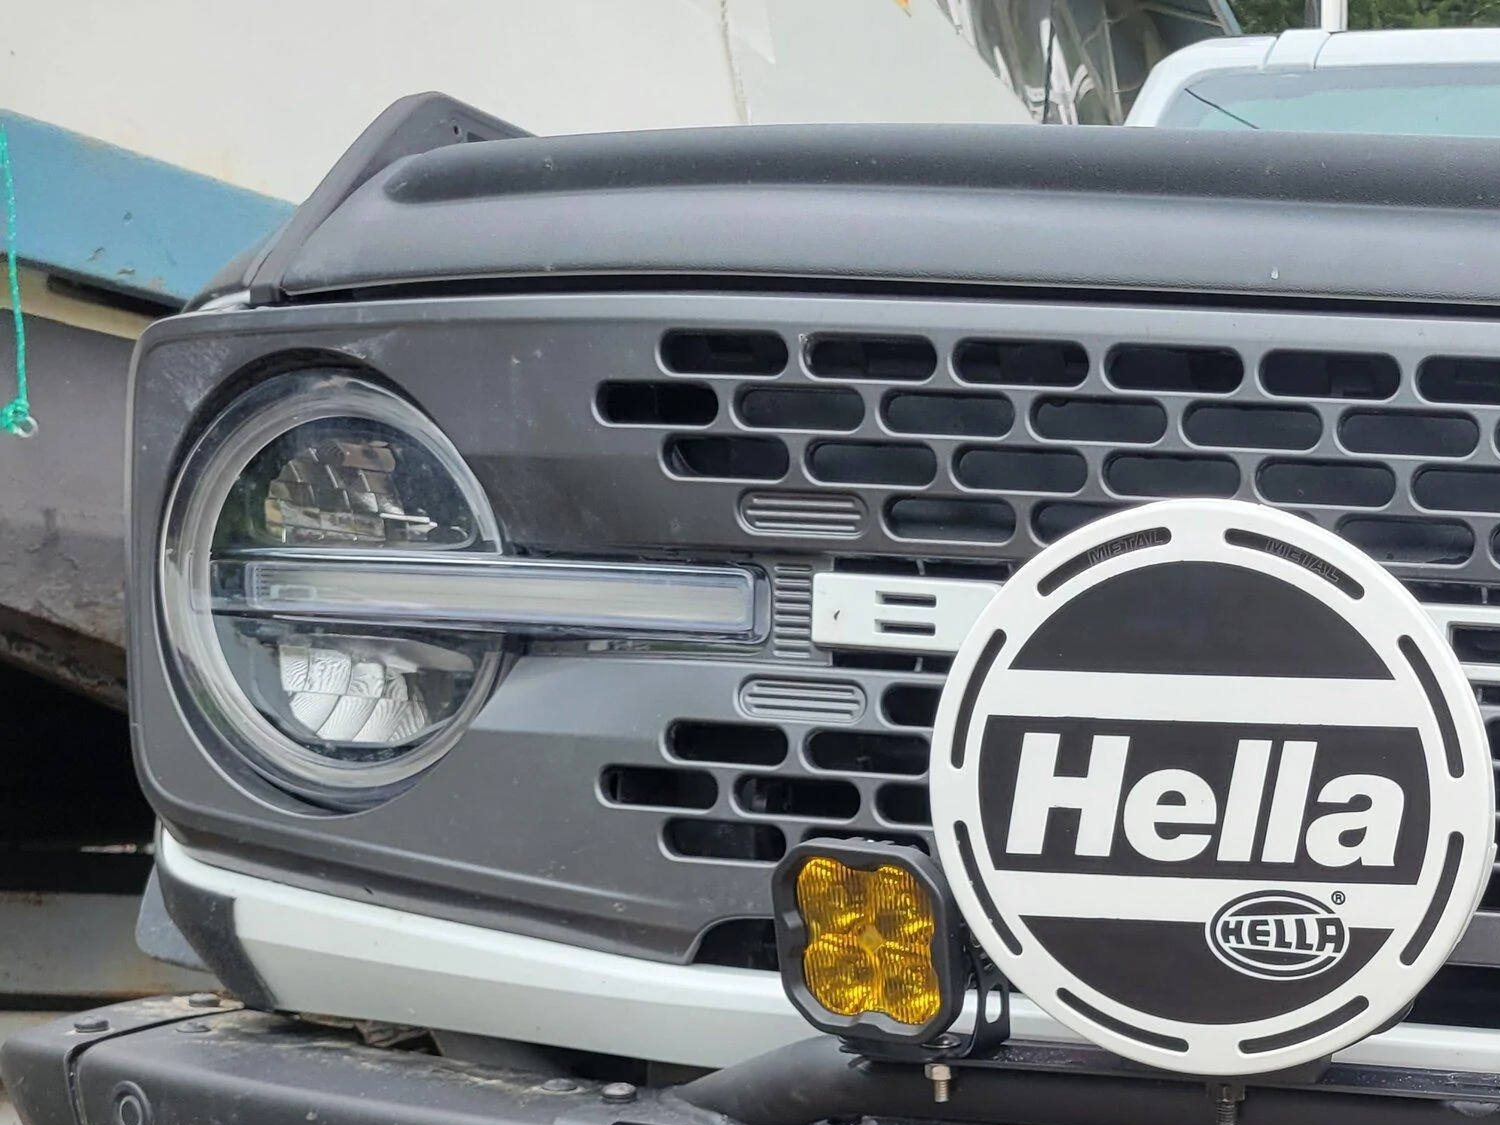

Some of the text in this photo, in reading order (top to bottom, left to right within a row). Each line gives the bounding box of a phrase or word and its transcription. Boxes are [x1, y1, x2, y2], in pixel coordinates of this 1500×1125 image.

[1265, 539, 1339, 582] METAL
[1006, 733, 1404, 867] Hella
[1220, 917, 1346, 954] HELLA
